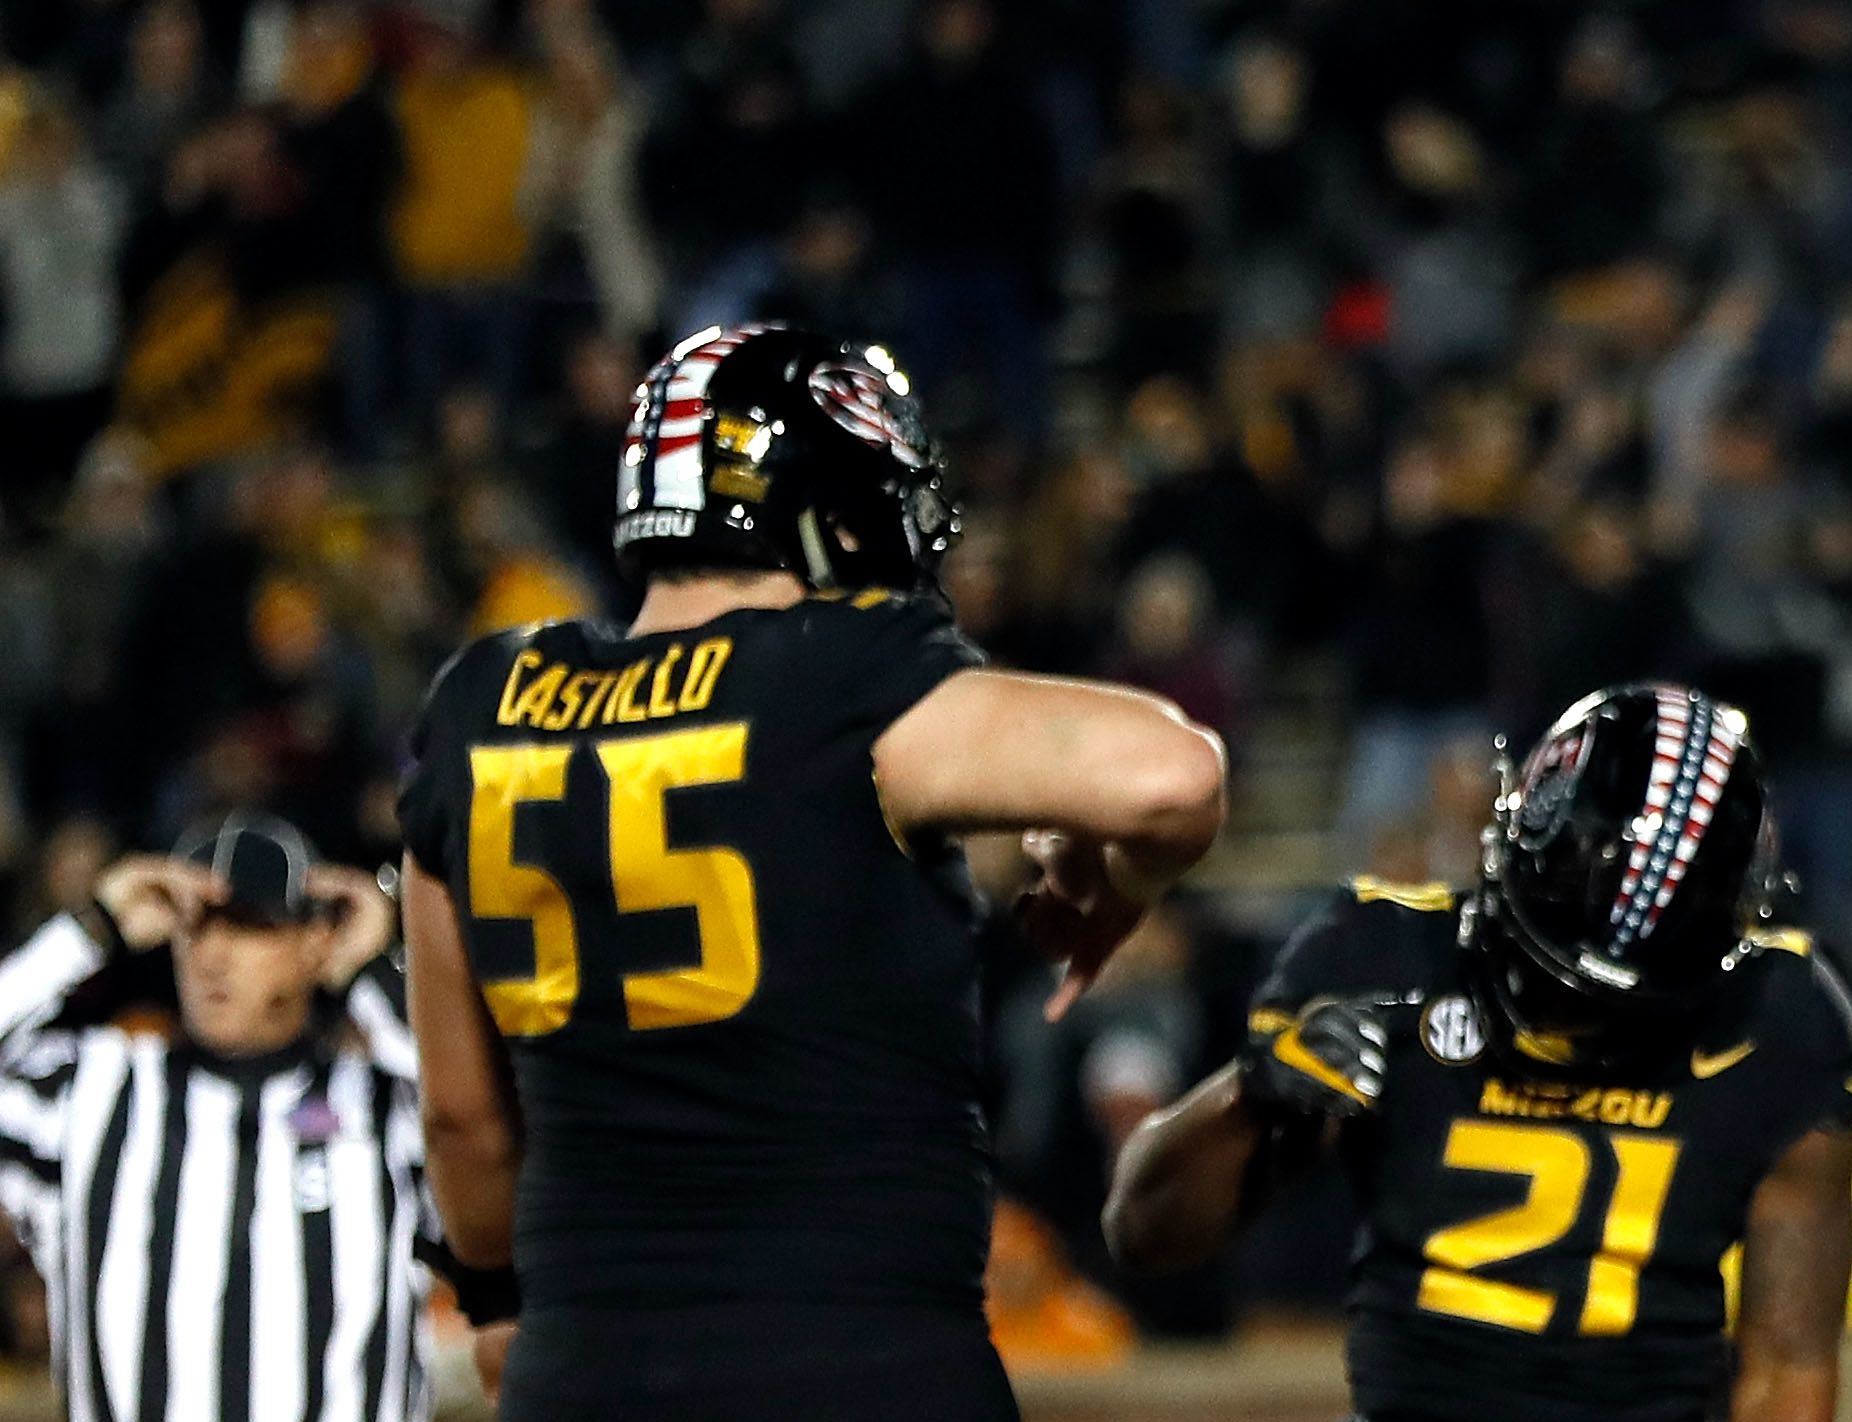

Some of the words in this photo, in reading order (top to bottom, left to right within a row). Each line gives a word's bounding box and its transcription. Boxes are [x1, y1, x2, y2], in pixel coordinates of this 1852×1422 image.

[498, 637, 733, 731] CASTILLO
[467, 721, 759, 1036] 55
[1417, 1119, 1682, 1335] 21
